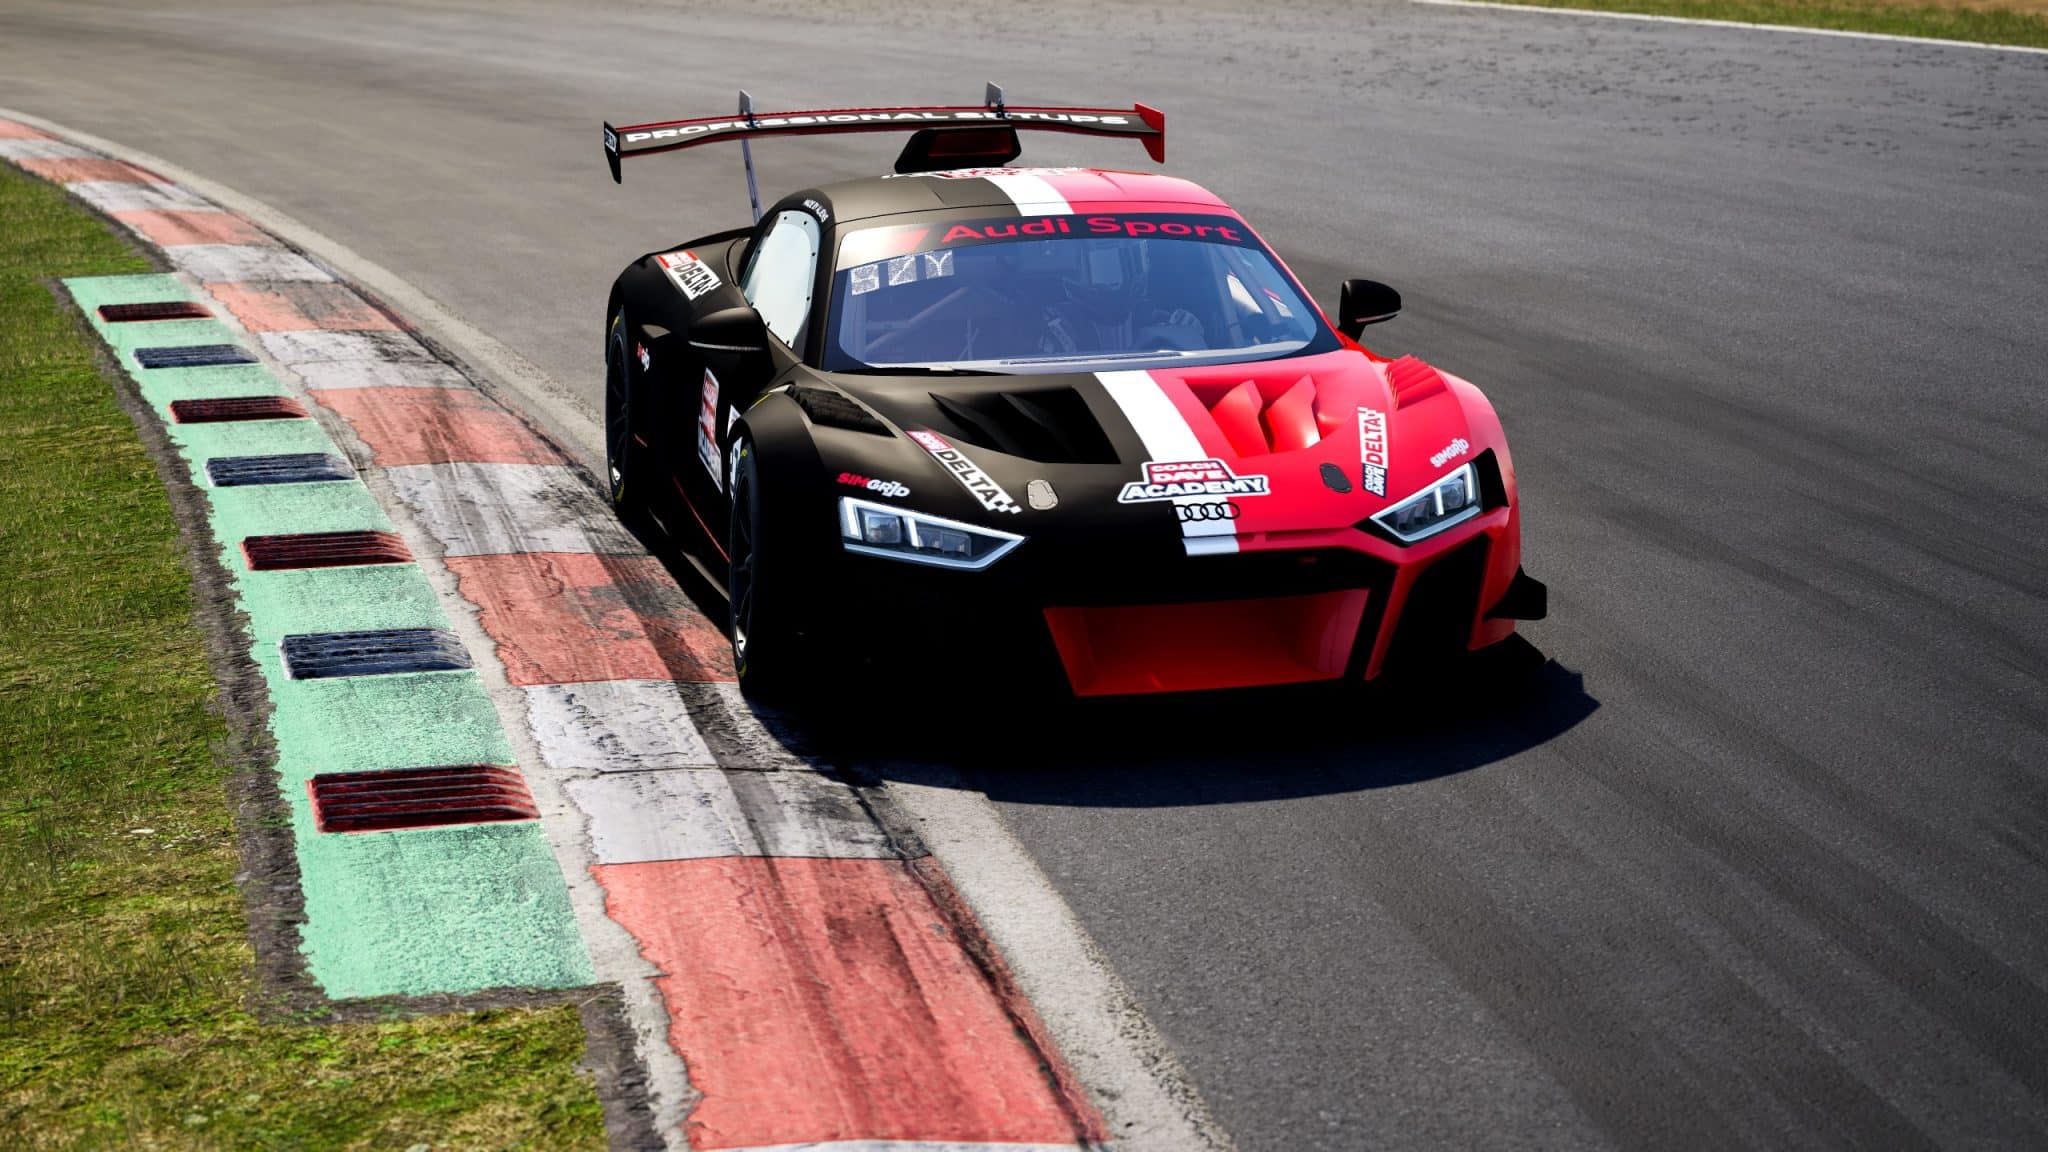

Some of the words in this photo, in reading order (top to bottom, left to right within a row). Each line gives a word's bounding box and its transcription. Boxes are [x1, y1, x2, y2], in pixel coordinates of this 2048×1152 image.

[941, 218, 1070, 243] Audi
[1089, 217, 1243, 242] Sport
[674, 262, 713, 295] DELTA
[1364, 413, 1383, 466] DELTA
[937, 450, 1000, 503] DELTA
[1151, 462, 1220, 472] COACH
[1152, 470, 1227, 482] DAVE
[1124, 478, 1264, 499] ACADEMY
